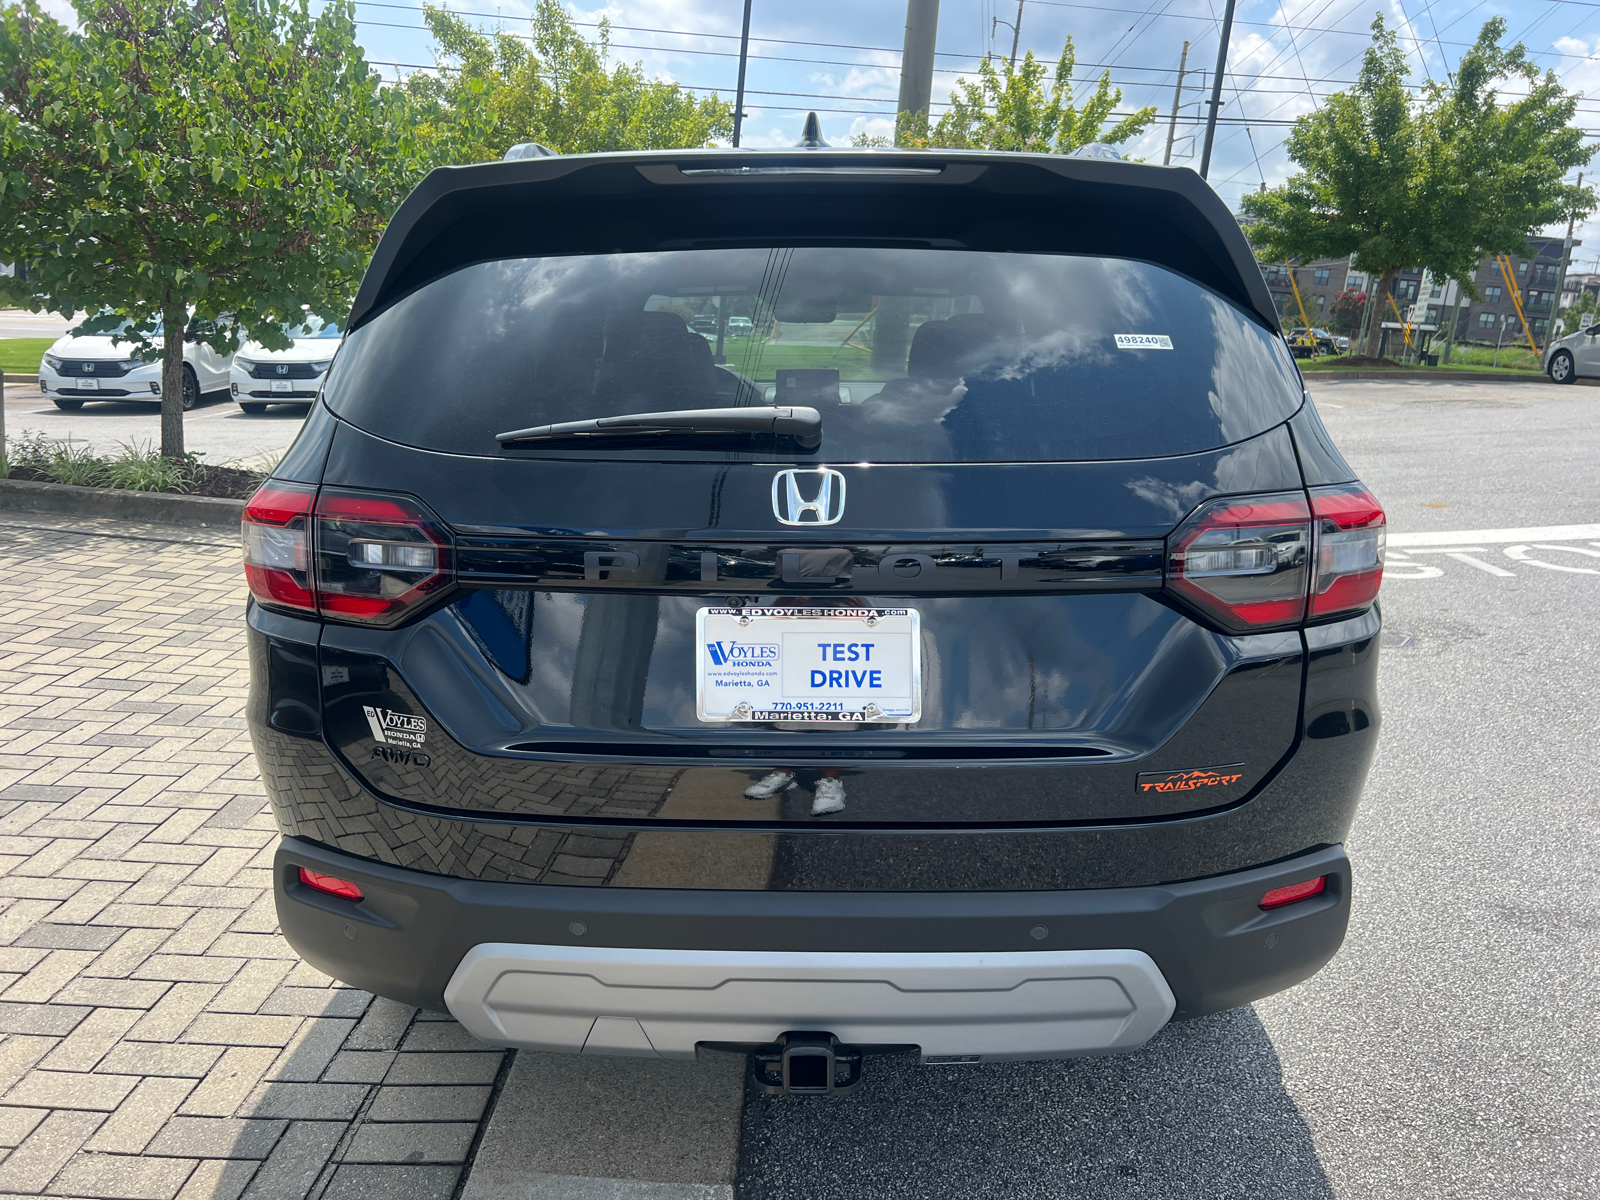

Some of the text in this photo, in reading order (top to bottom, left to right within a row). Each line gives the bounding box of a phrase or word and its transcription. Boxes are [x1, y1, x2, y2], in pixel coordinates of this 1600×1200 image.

[1117, 336, 1159, 344] 498240
[584, 551, 1039, 582] PILOT
[1382, 540, 1600, 580] STO
[715, 640, 777, 664] VOYLES
[817, 643, 875, 662] TEST
[715, 680, 754, 688] Marietta,
[810, 670, 882, 688] DRIVE
[366, 710, 375, 718] ED
[772, 702, 844, 710] 770-951-2211
[375, 707, 425, 732] VOYLES
[754, 711, 863, 721] Marietta, GA
[384, 730, 417, 740] HONDA
[387, 738, 412, 748] Marietta,
[371, 745, 431, 768] AWD
[1140, 774, 1243, 792] TRAILSPORT
